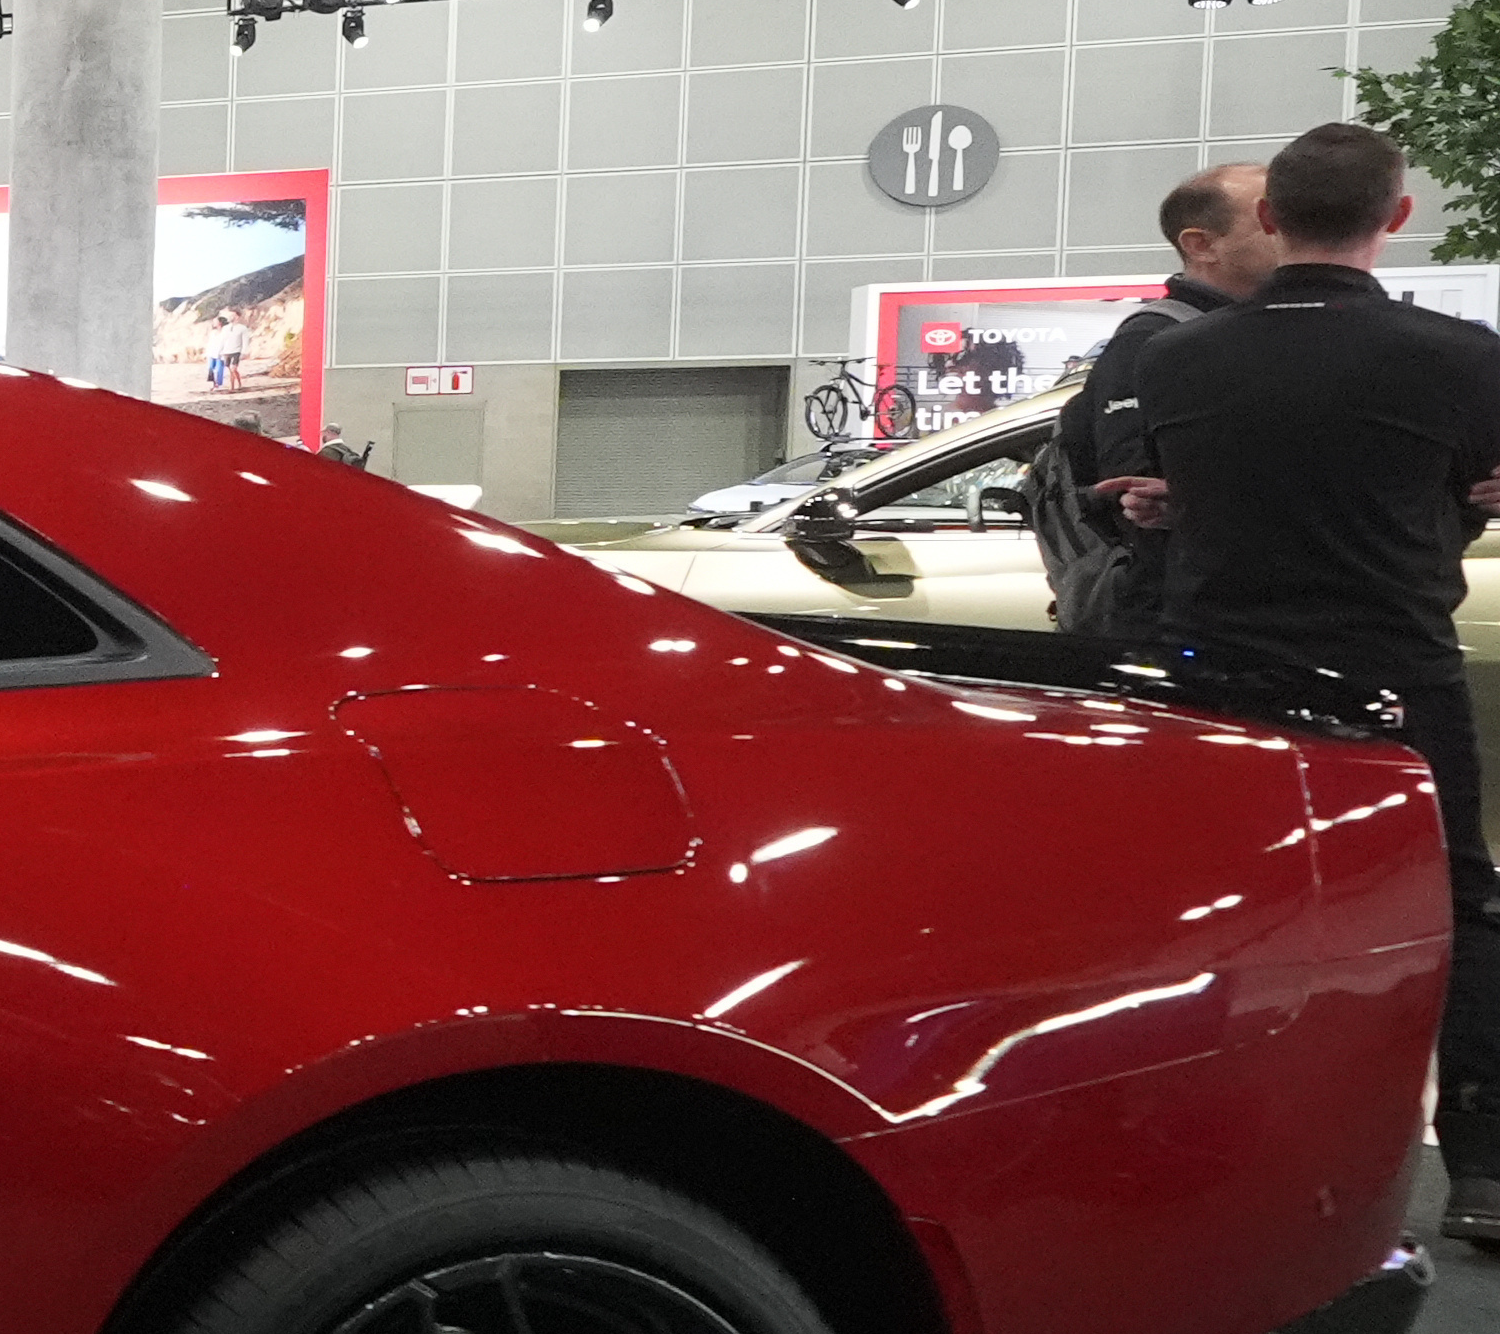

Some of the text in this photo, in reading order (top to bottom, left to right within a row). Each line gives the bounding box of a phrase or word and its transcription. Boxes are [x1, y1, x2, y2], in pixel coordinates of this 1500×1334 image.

[968, 327, 1067, 344] TOYOTA
[917, 370, 981, 395] Let
[915, 404, 982, 431] tim
